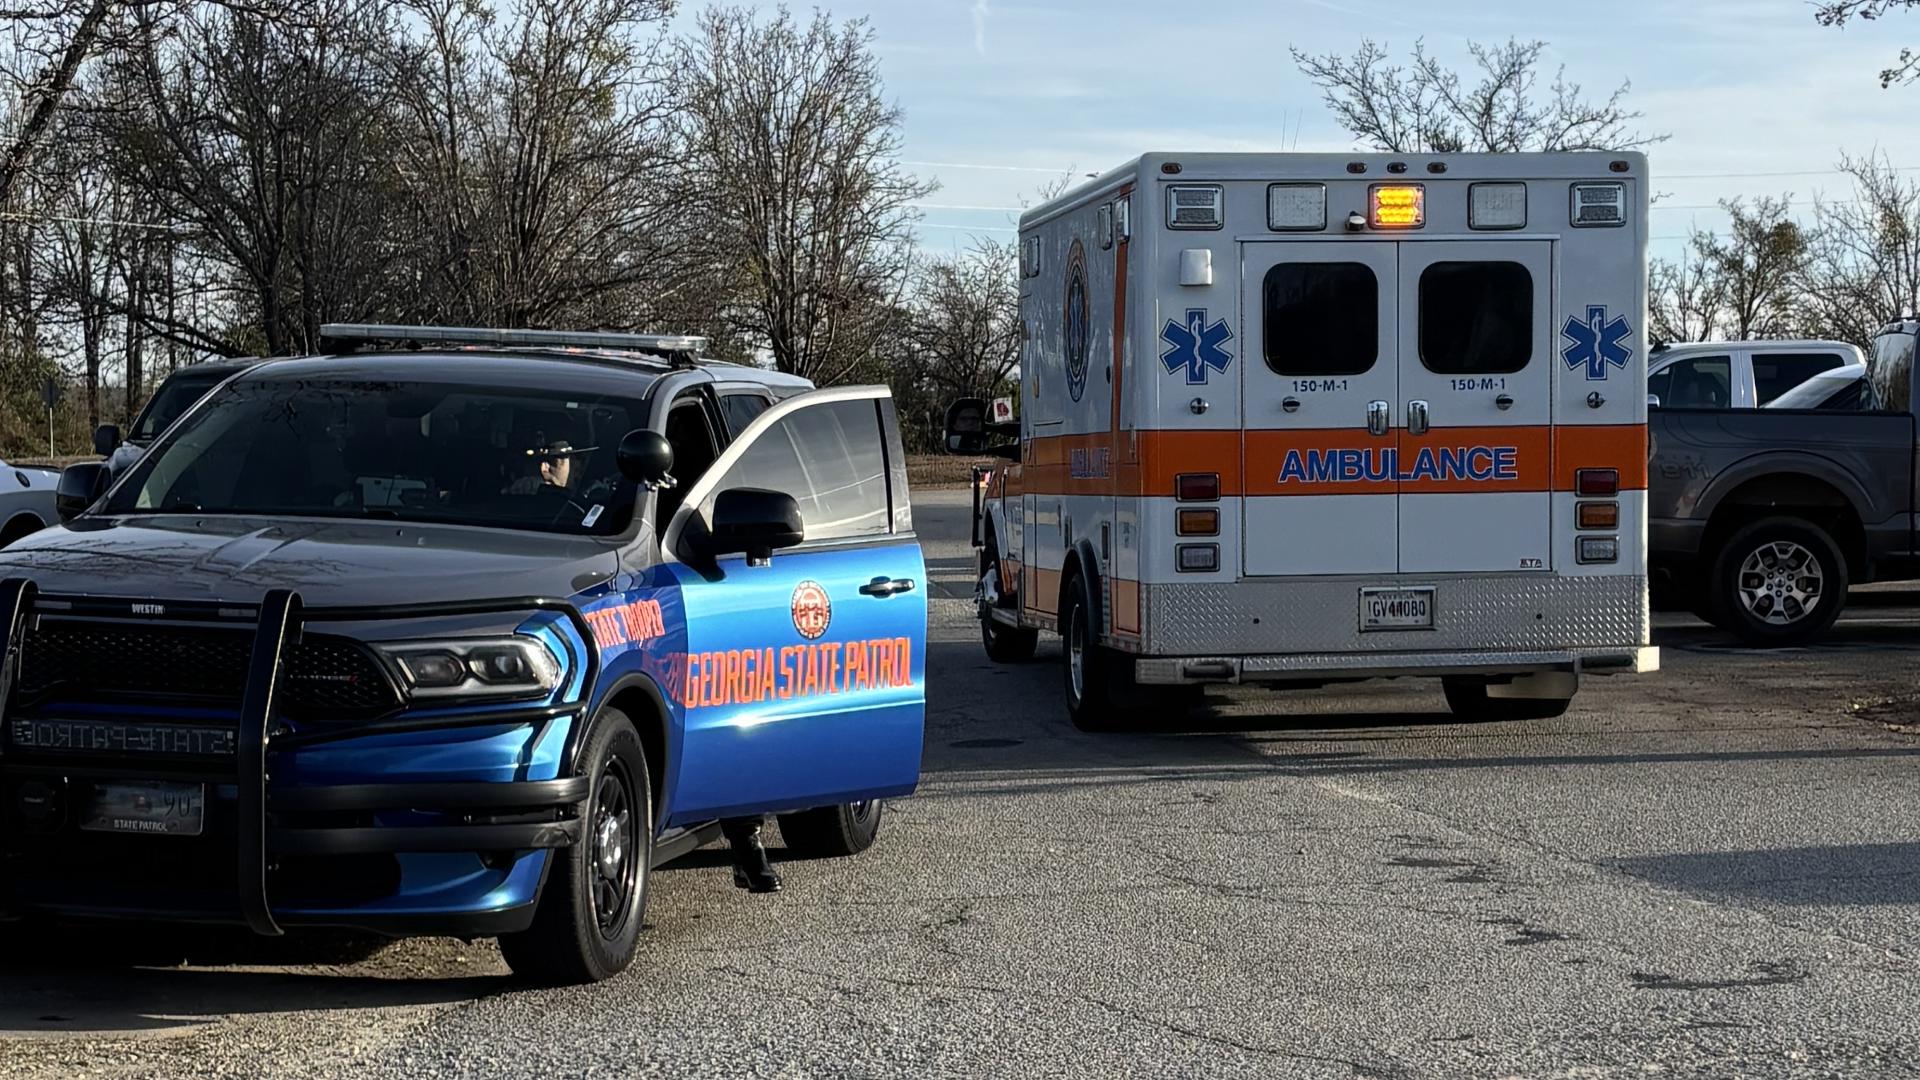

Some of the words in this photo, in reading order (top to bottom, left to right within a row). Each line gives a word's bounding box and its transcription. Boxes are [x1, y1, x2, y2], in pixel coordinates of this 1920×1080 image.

[1291, 379, 1349, 393] 150-M-1
[1450, 378, 1506, 392] 150-M-1
[1277, 445, 1519, 484] AMBULANCE
[131, 603, 165, 615] WESTIN
[684, 647, 775, 709] GEORGIA
[779, 642, 841, 699] STATE
[844, 637, 914, 692] PATROL
[113, 819, 138, 830] STATE
[138, 820, 168, 832] PATROL
